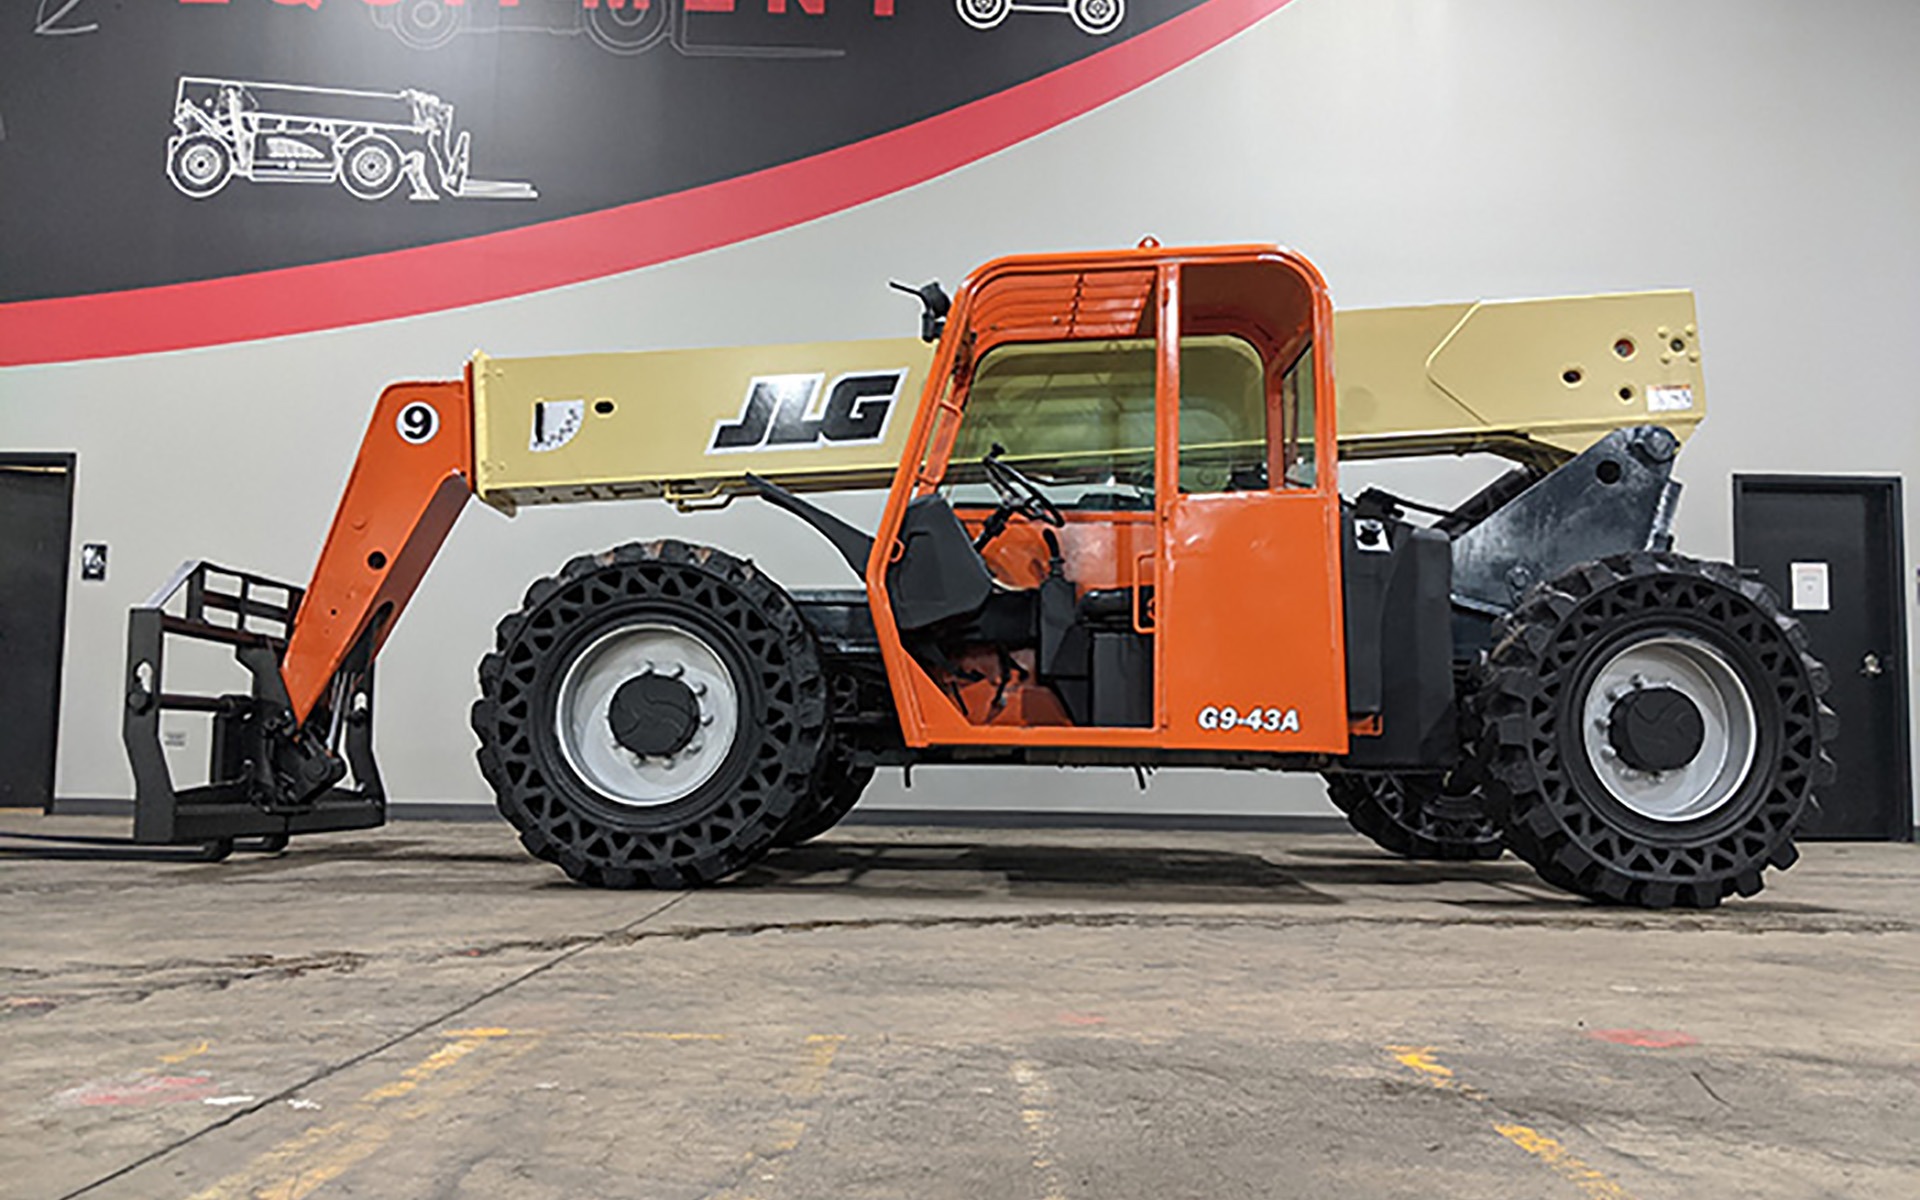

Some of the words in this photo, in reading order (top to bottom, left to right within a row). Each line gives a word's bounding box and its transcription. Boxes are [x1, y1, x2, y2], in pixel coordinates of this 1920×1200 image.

[404, 405, 432, 440] 9
[710, 371, 904, 451] JLG
[1198, 706, 1300, 732] G9-43A
